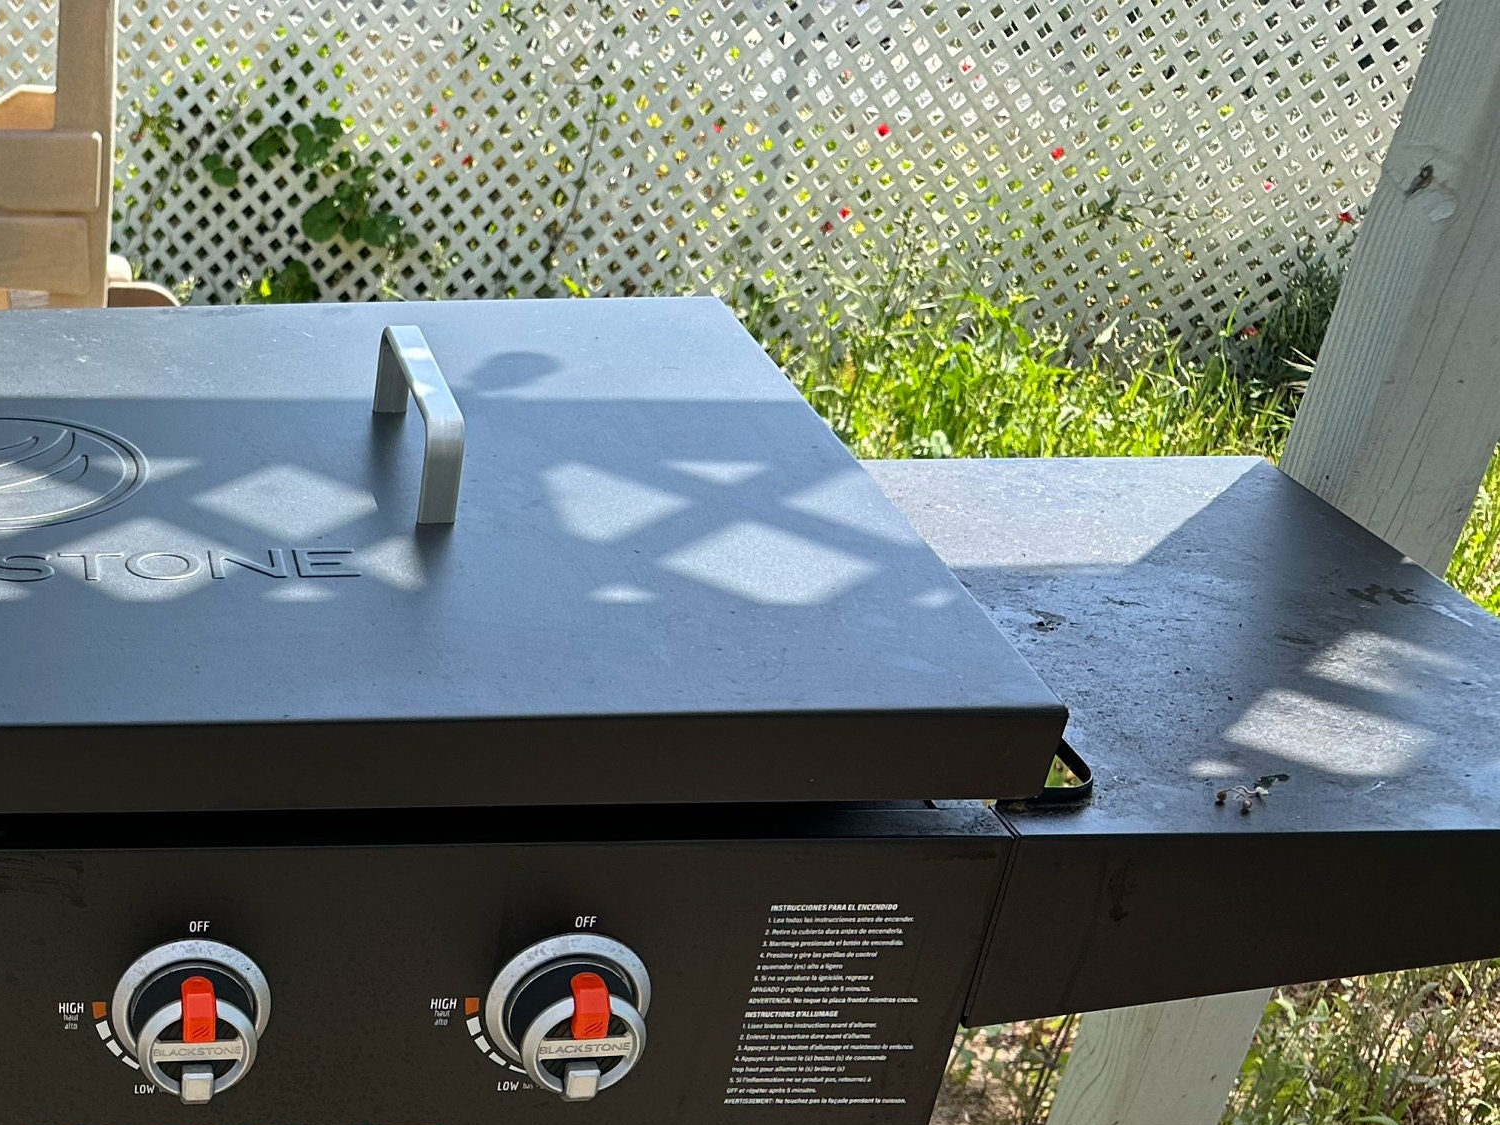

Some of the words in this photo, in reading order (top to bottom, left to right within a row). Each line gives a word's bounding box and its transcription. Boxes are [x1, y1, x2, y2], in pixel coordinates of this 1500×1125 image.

[857, 903, 898, 911] ENCENDIDO
[189, 920, 211, 933] OFF
[574, 916, 597, 928] OFF
[58, 1002, 84, 1014] HIGH
[430, 998, 457, 1010] HIGH
[744, 1010, 795, 1018] INSTRUCTIONS
[796, 1010, 839, 1018] D'ALLUMAGE
[153, 1047, 242, 1057] BLACKSTONE
[538, 1042, 631, 1055] BLACKSTONE
[134, 1084, 155, 1095] LOW
[497, 1081, 520, 1091] LOW
